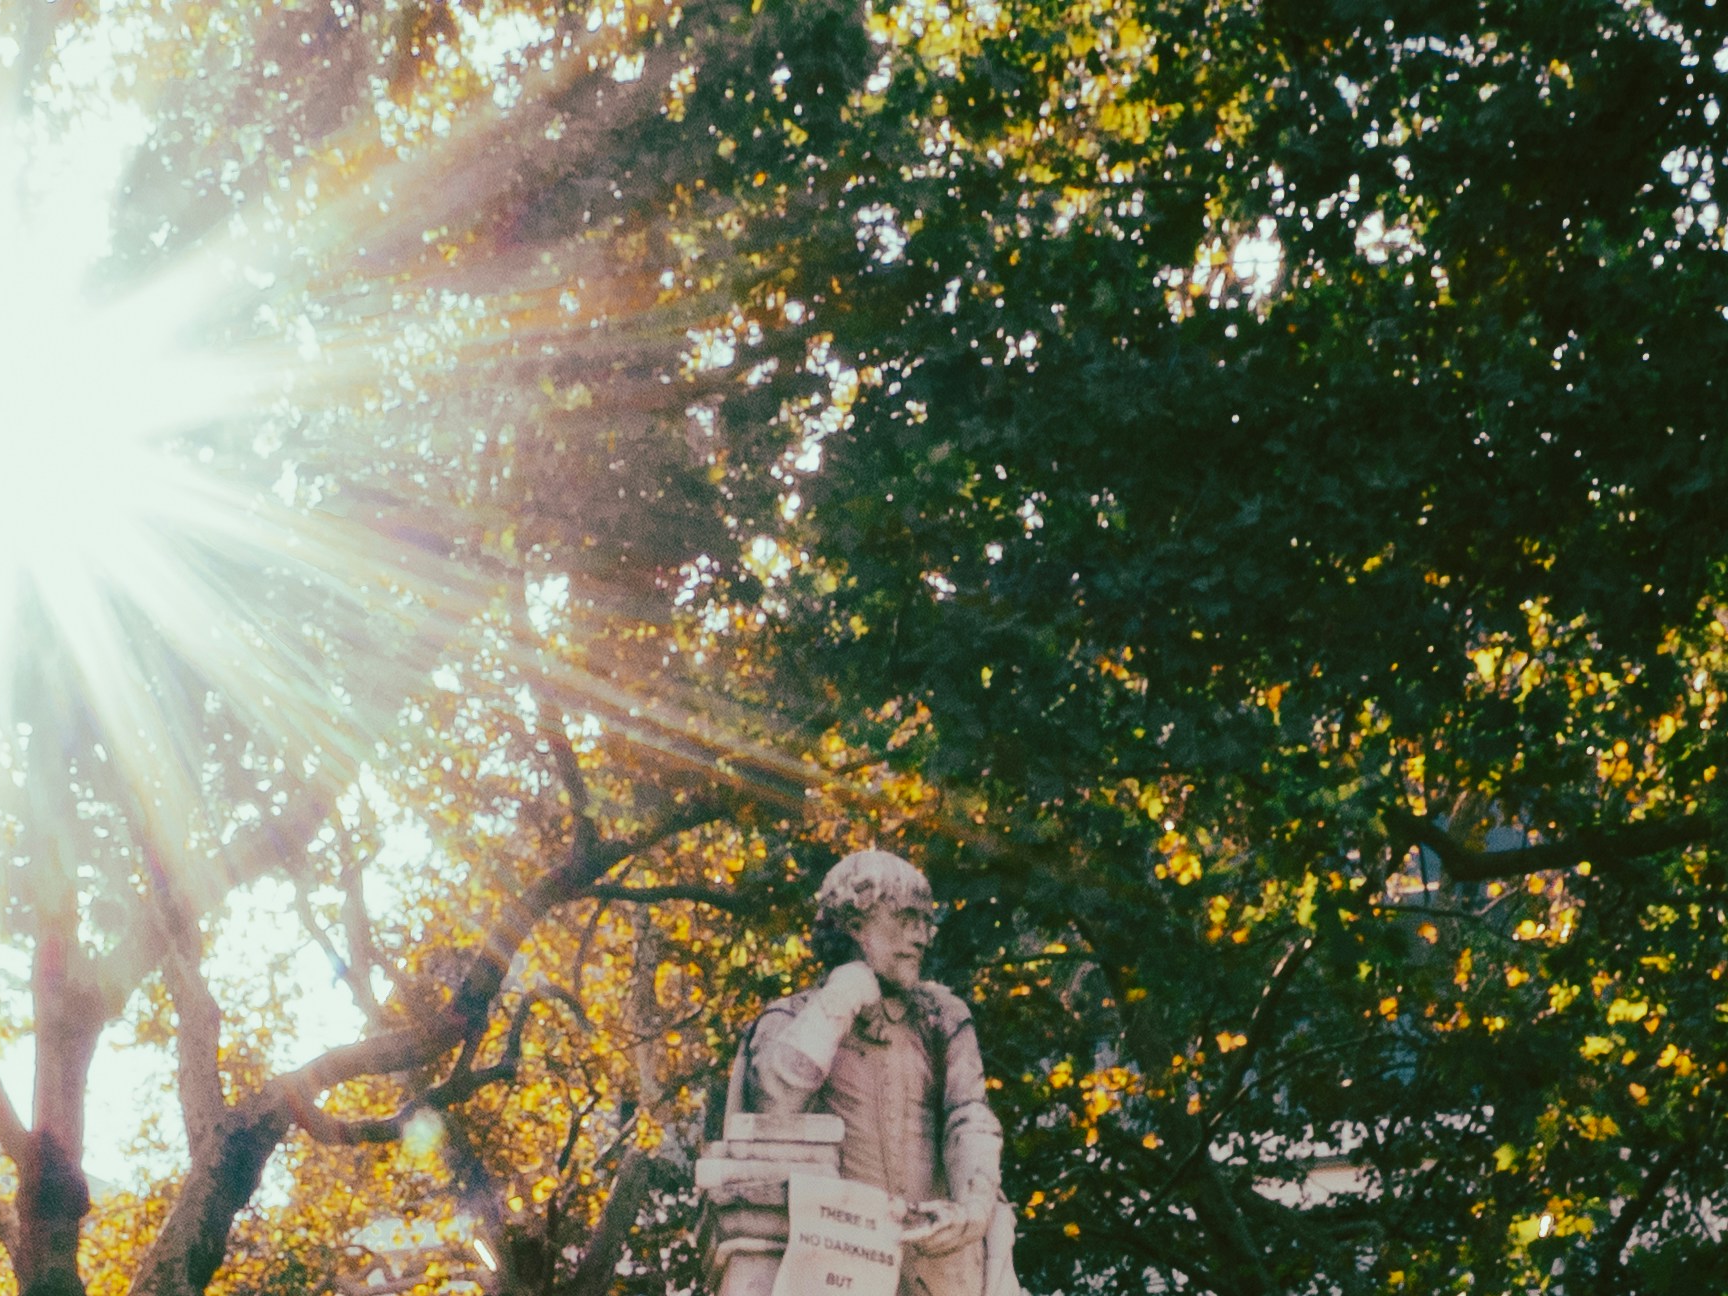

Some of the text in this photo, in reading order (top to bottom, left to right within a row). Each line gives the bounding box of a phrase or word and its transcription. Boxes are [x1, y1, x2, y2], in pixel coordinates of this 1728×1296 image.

[820, 1205, 876, 1231] THERE IS
[800, 1232, 894, 1267] NO DARKNESS
[826, 1272, 853, 1290] BUT
